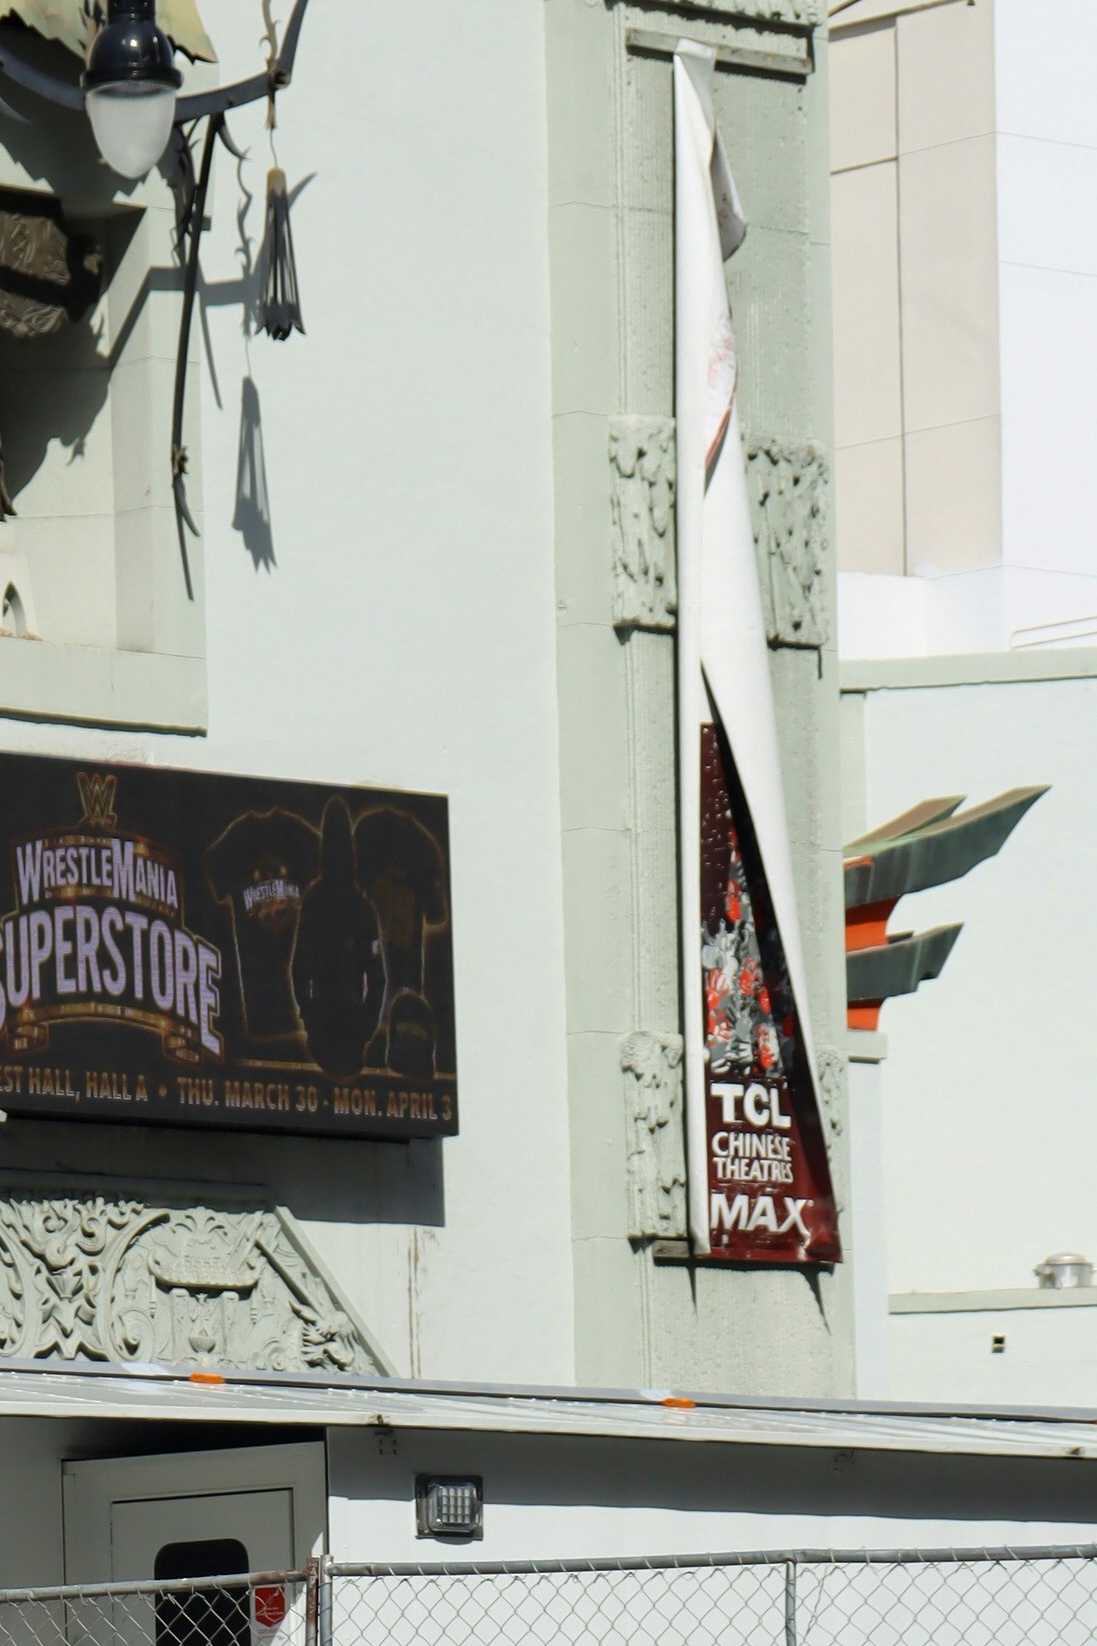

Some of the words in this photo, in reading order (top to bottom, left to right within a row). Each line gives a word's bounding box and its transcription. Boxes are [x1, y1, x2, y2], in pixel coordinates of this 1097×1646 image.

[28, 1067, 82, 1104] HALL,
[85, 1071, 133, 1100] HALL
[135, 1074, 149, 1102] A
[177, 1076, 220, 1106] THU.
[223, 1080, 291, 1111] MARCH
[294, 1084, 319, 1112] 30
[333, 1086, 383, 1116] MON.
[386, 1090, 438, 1120] APRIL
[442, 1093, 452, 1120] 3
[710, 1082, 792, 1129] TCL
[711, 1131, 792, 1161] CHINESE
